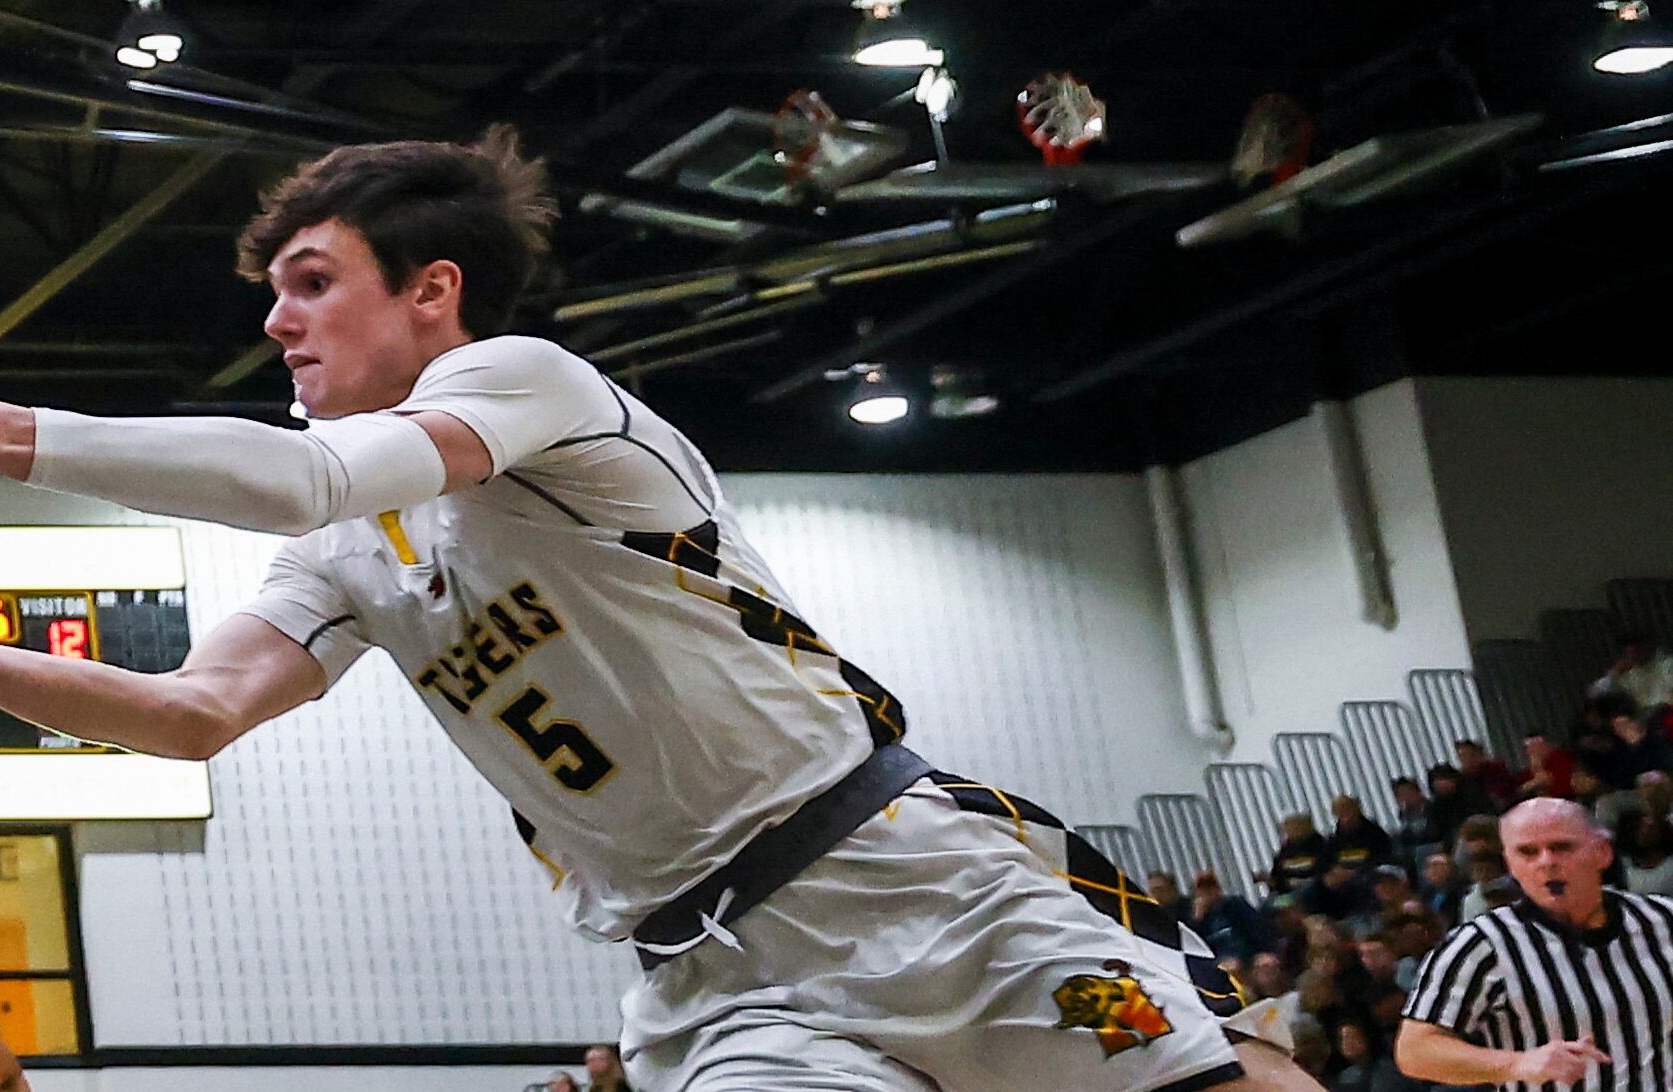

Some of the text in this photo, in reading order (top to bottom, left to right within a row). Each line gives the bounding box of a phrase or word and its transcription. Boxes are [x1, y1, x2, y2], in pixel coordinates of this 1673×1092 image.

[48, 619, 89, 659] 12
[414, 580, 565, 717] TIGERS
[493, 684, 617, 795] 5
